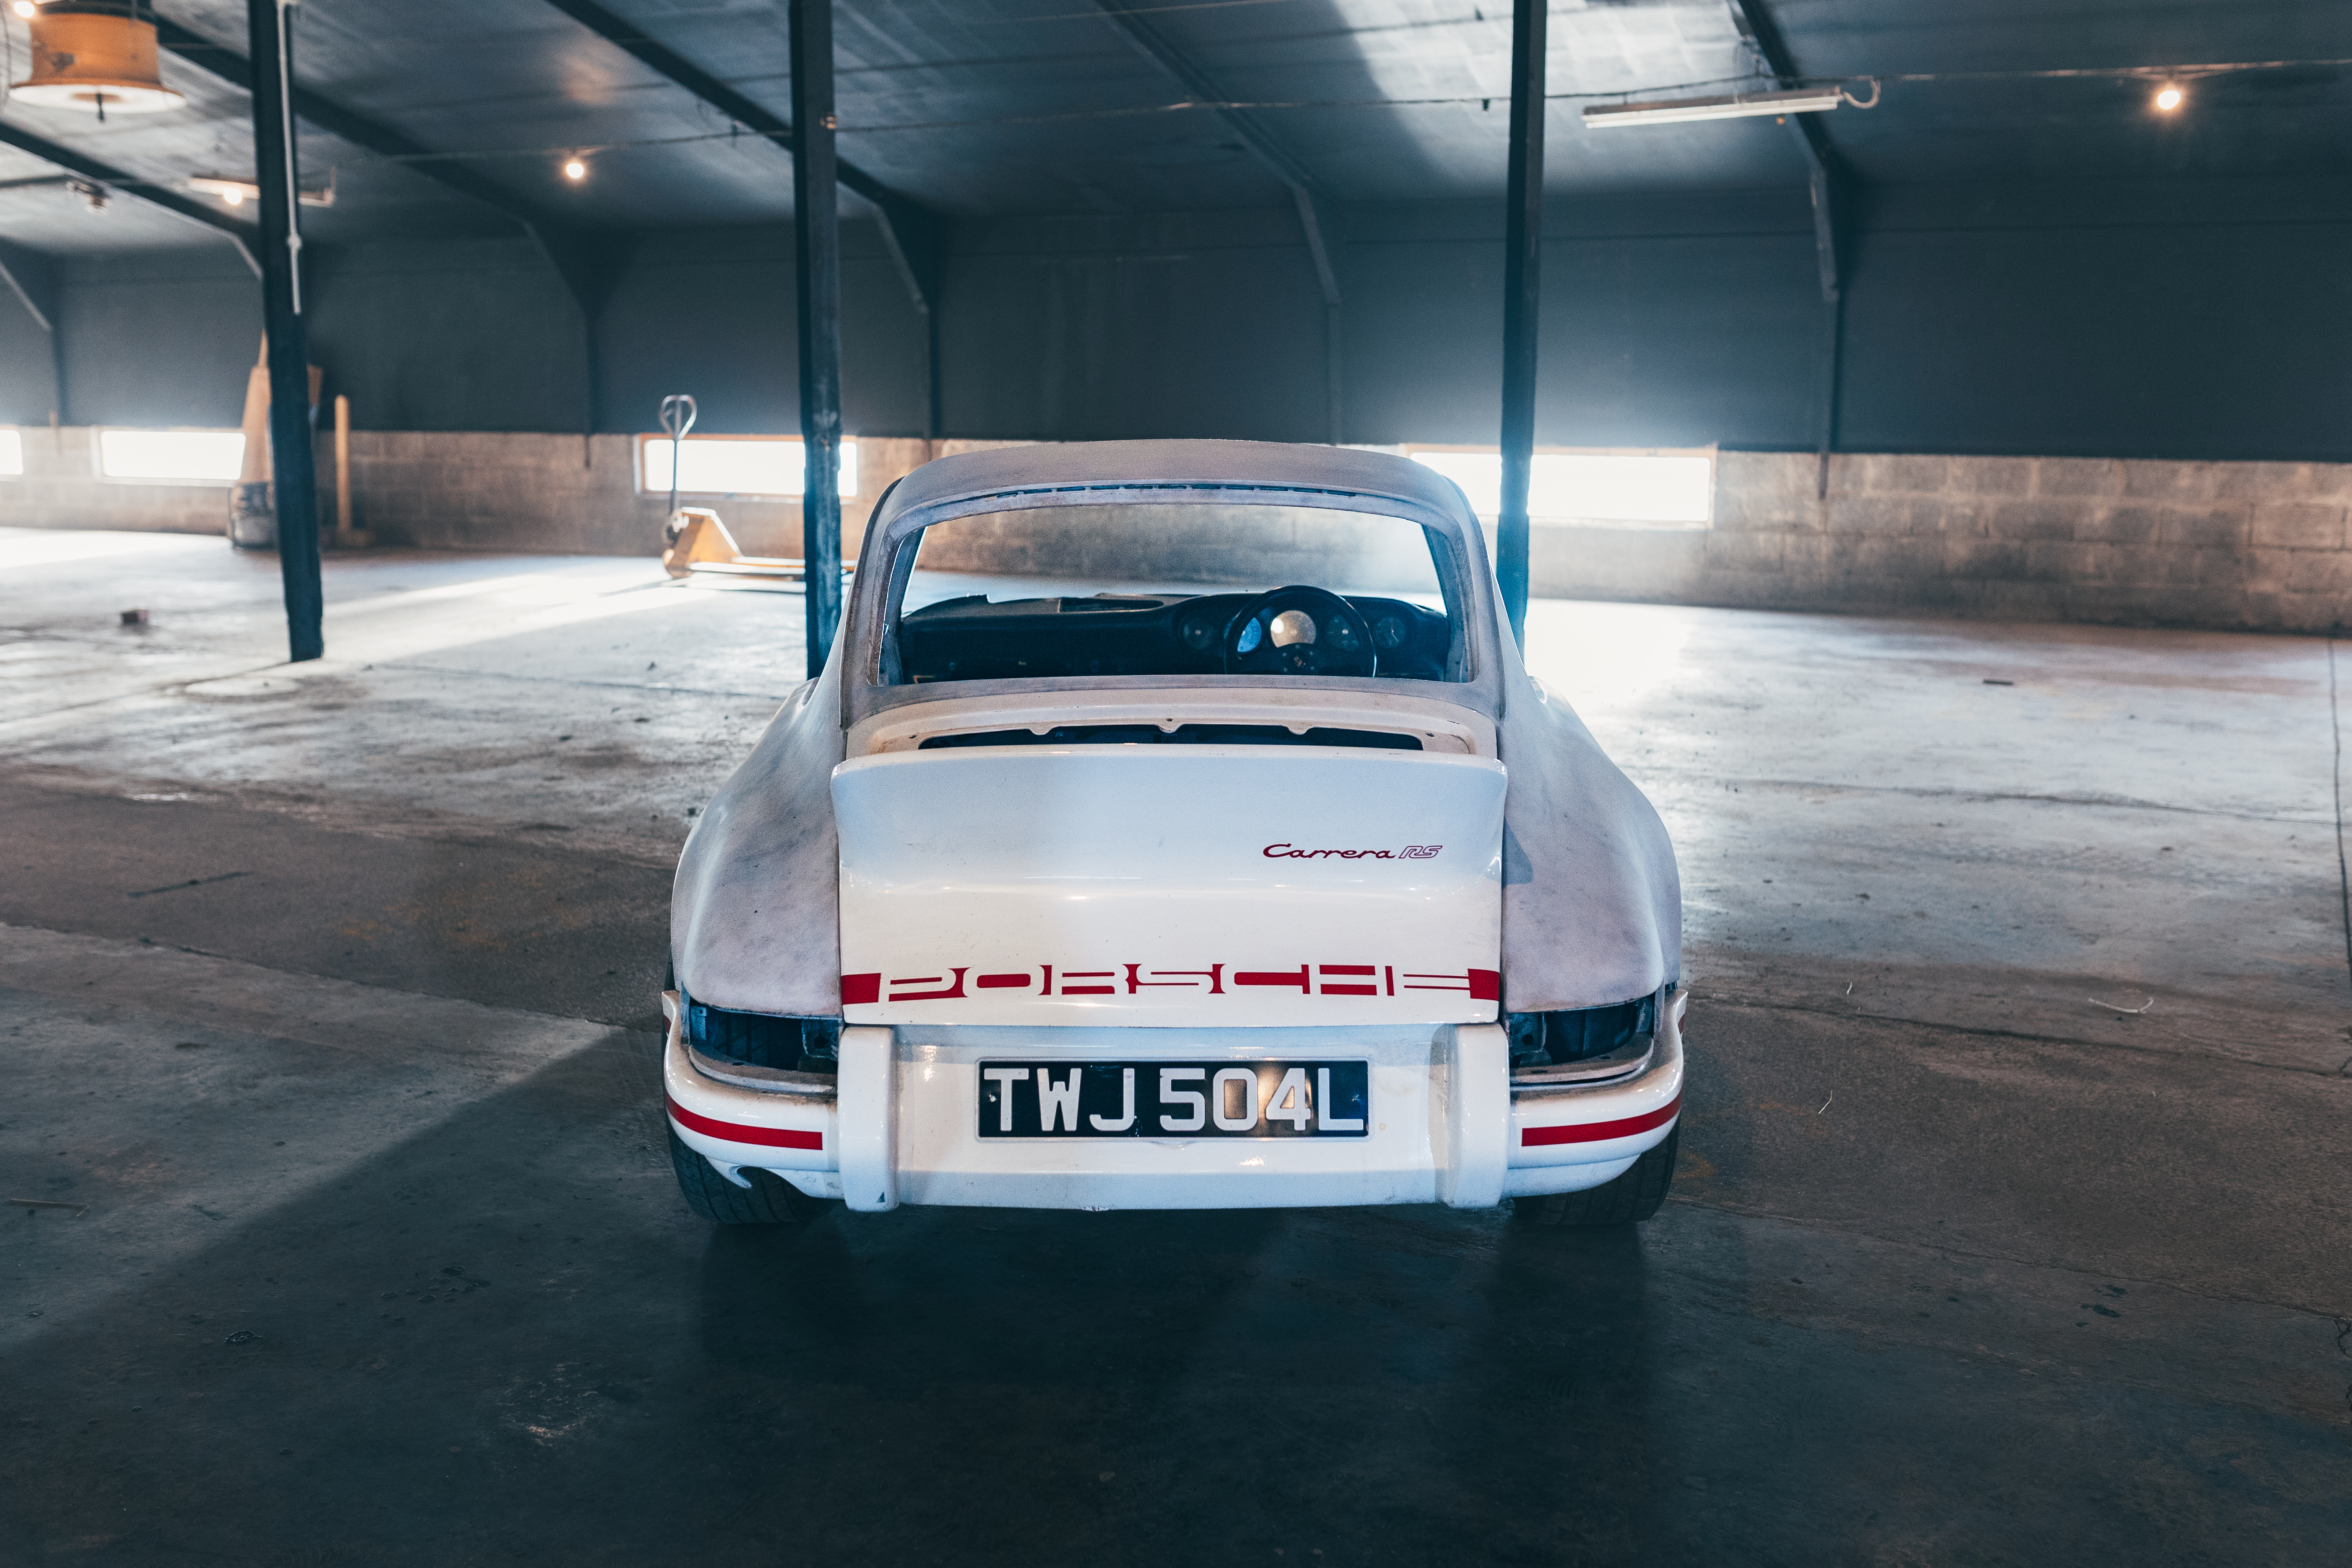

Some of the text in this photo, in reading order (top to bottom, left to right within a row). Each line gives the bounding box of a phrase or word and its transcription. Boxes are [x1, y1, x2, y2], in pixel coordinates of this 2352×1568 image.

[1263, 843, 1443, 859] Carrera RS
[877, 963, 1468, 1002] PORSCHE
[984, 1068, 1364, 1131] TWJ 504L
